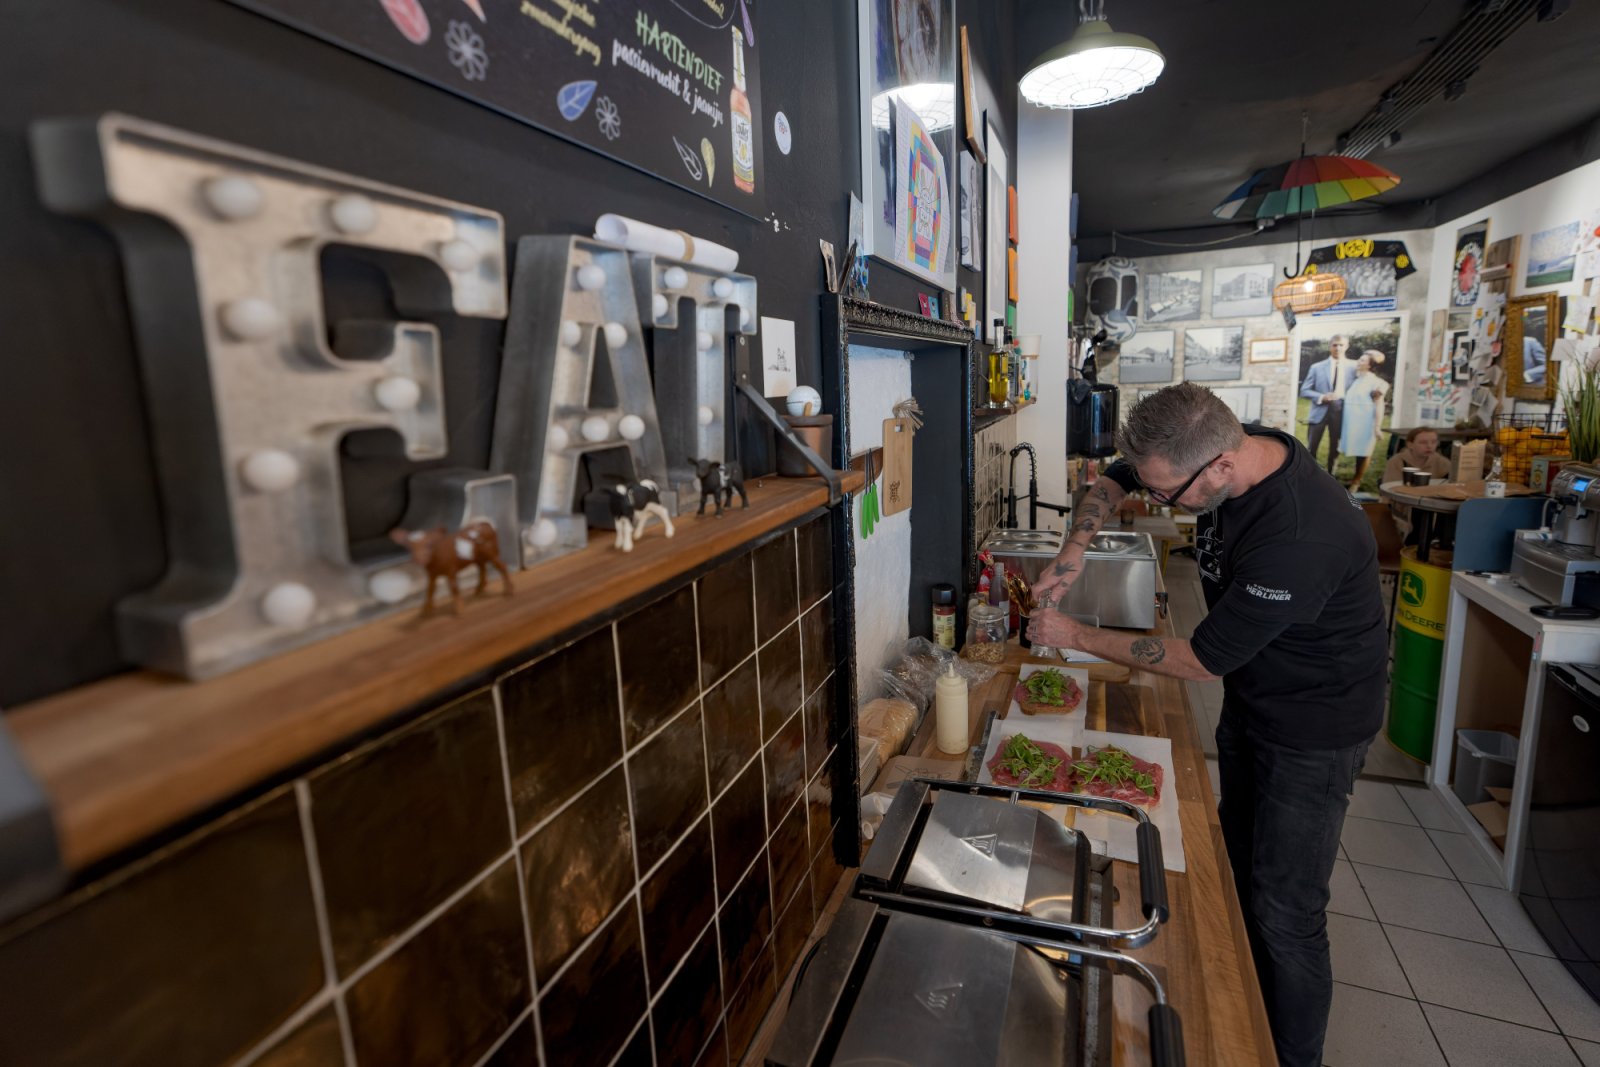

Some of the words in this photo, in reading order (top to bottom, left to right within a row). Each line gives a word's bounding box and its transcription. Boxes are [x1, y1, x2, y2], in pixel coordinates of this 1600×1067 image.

[635, 10, 725, 95] HARTENDIEF
[682, 78, 691, 105] &
[32, 110, 758, 682] EAT
[1246, 584, 1292, 601] HERLINER
[1404, 610, 1445, 632] DEERE
